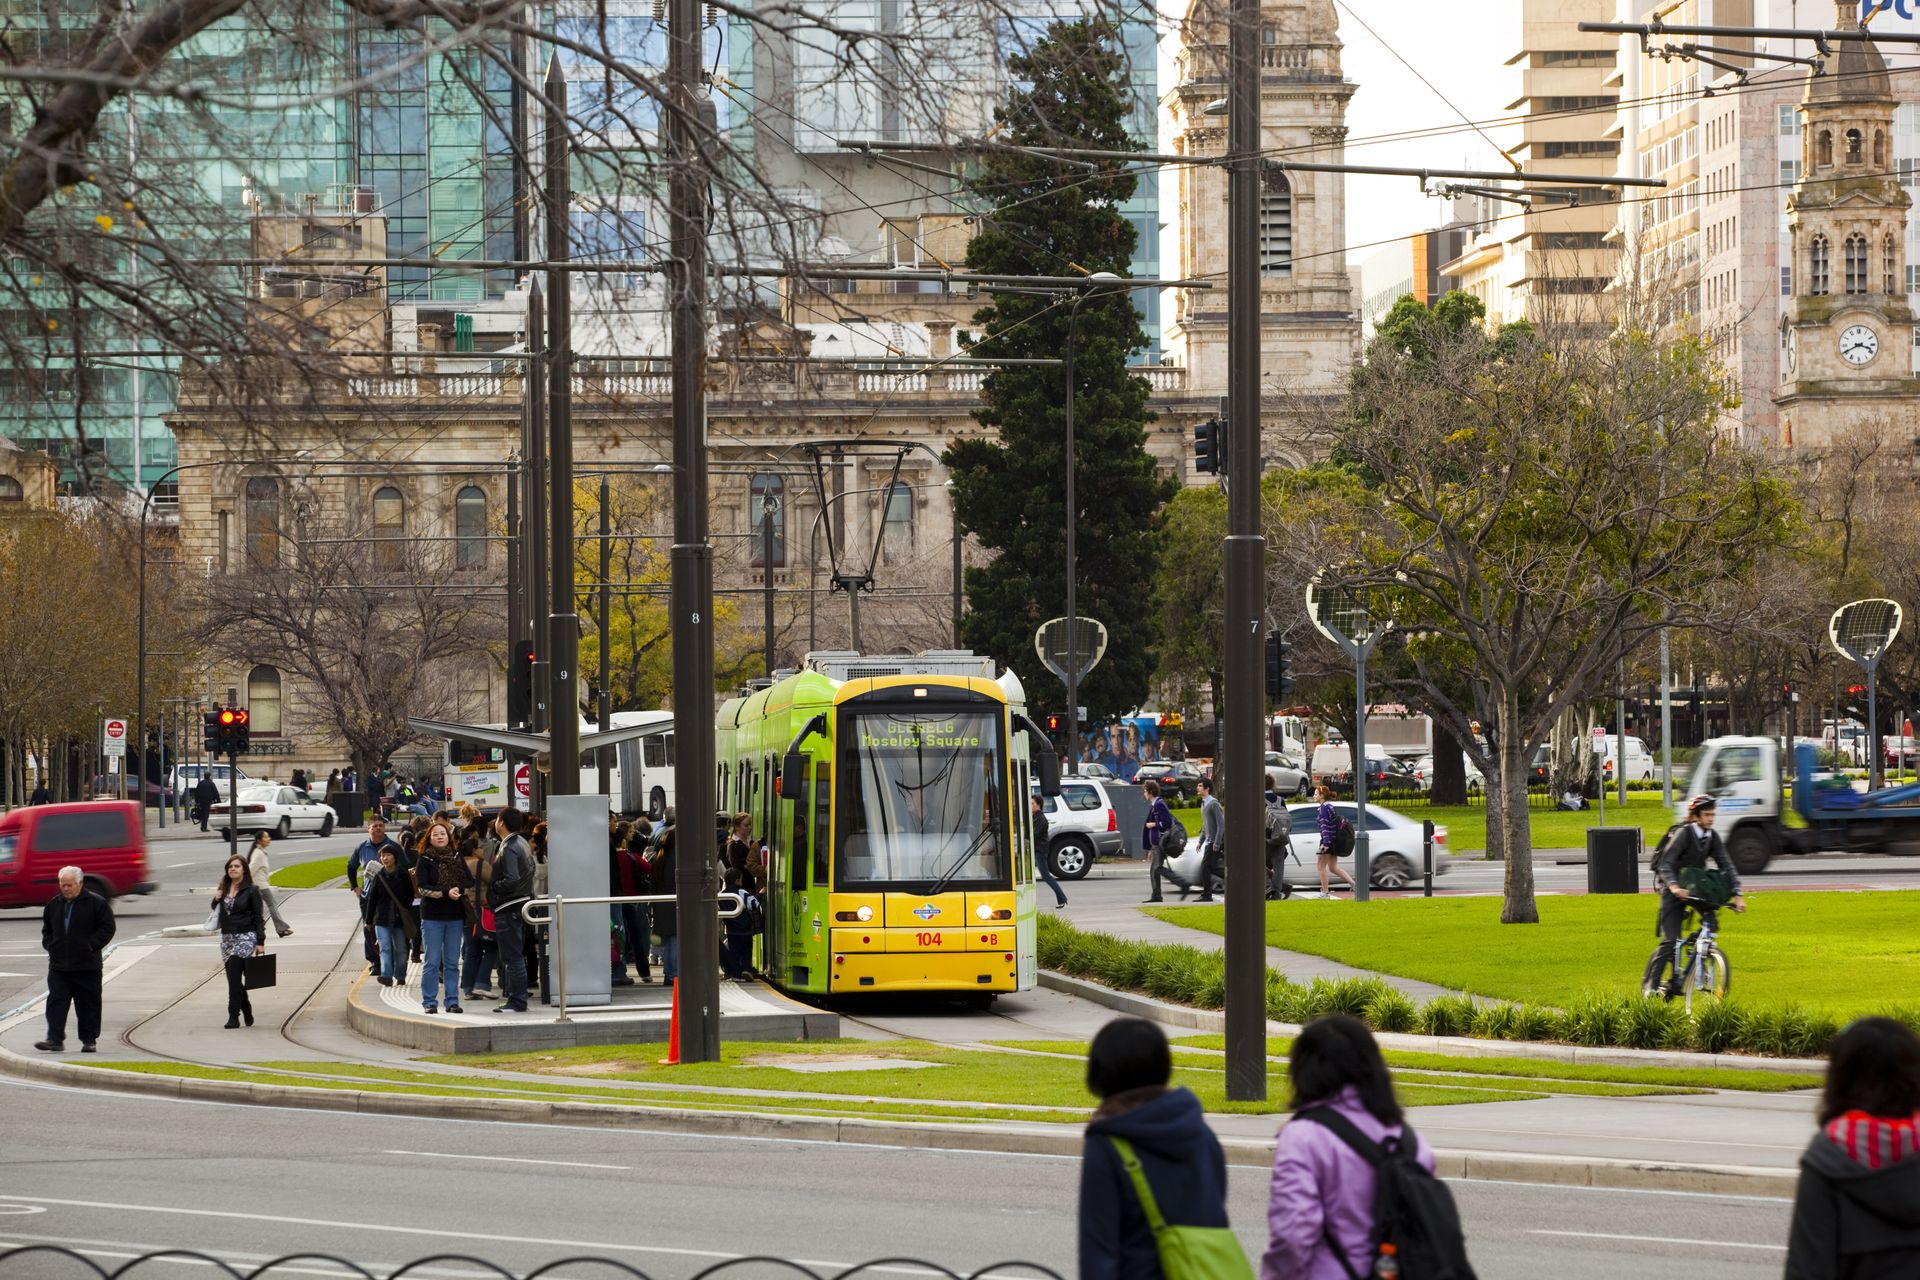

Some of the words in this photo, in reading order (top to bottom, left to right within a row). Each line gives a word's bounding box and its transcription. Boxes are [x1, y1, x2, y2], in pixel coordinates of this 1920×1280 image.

[692, 612, 700, 624] 8
[1250, 620, 1259, 633] 7
[560, 670, 568, 680] 9
[538, 702, 545, 710] 10
[887, 722, 954, 734] GLENELG
[861, 734, 920, 748] Moseley
[926, 734, 979, 748] Square
[915, 932, 942, 946] 104
[990, 934, 998, 945] B
